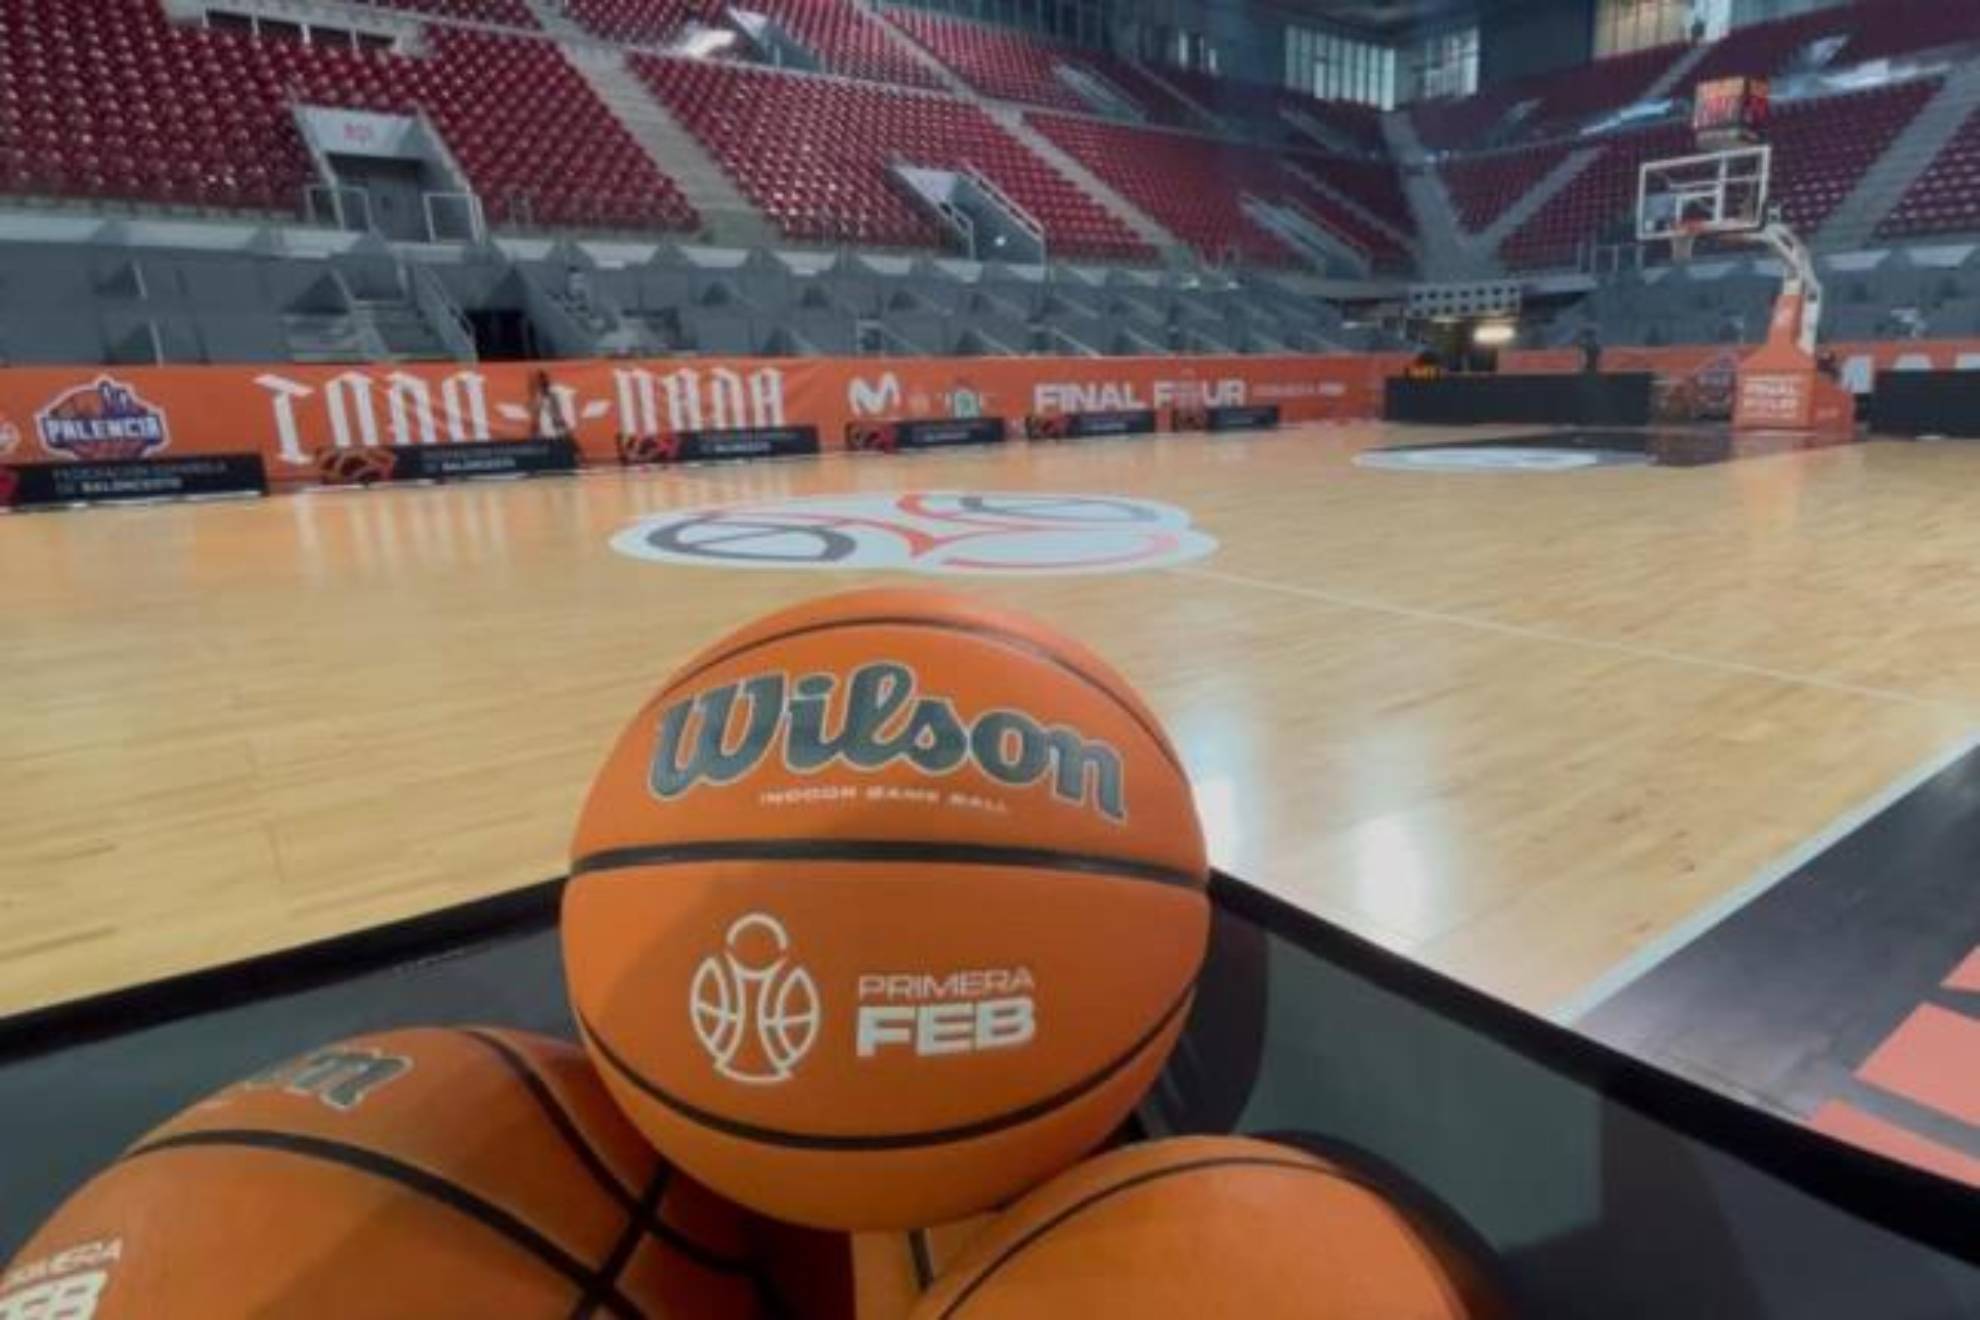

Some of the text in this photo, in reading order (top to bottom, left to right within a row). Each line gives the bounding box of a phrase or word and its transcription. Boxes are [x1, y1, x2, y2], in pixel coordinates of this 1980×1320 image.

[1034, 381, 1146, 414] FINAL
[1153, 378, 1247, 408] FUR
[47, 415, 161, 443] PALENCIA
[649, 663, 1126, 822] Wilson
[858, 967, 1035, 1001] PRIMERA
[856, 999, 1036, 1058] FEB
